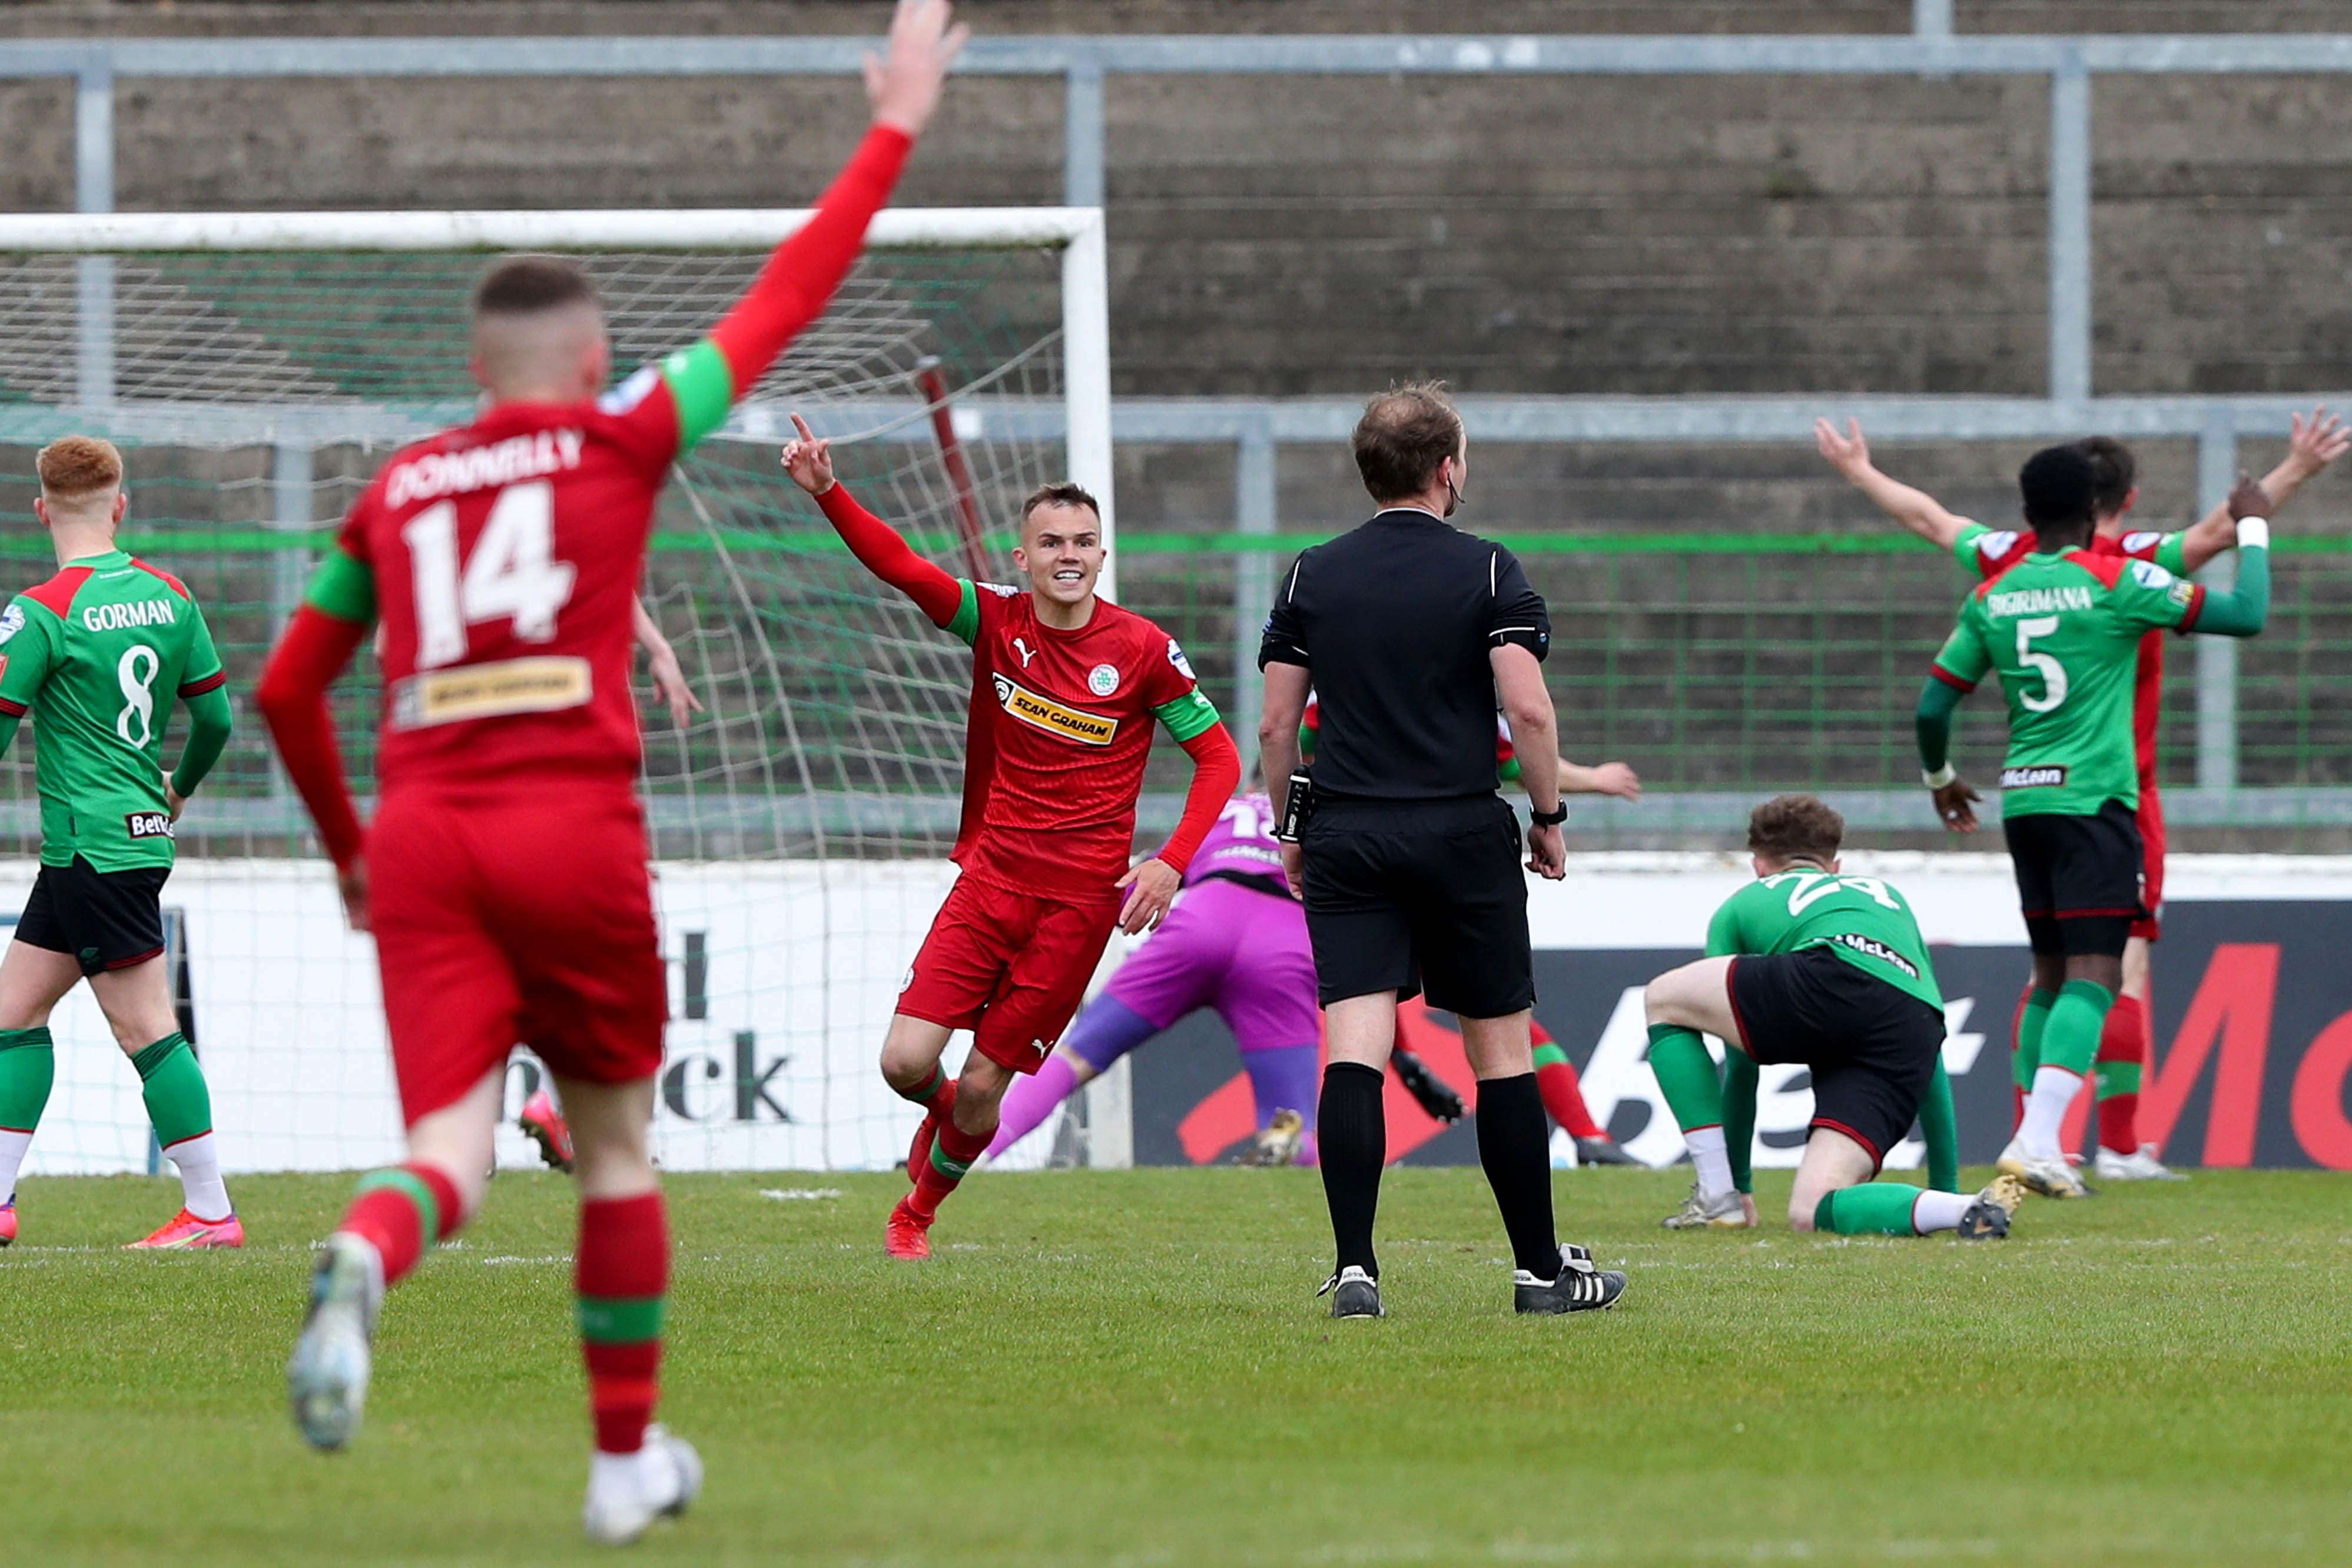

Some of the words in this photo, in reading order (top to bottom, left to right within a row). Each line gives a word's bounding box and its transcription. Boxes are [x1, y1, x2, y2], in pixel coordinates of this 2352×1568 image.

[401, 477, 578, 670] 14
[83, 599, 175, 632] GORMAN
[117, 645, 159, 750] 8
[2016, 616, 2068, 713] 5
[1014, 697, 1051, 719] SEAN
[1050, 712, 1108, 737] GRAHAM
[1764, 873, 1901, 917] 24
